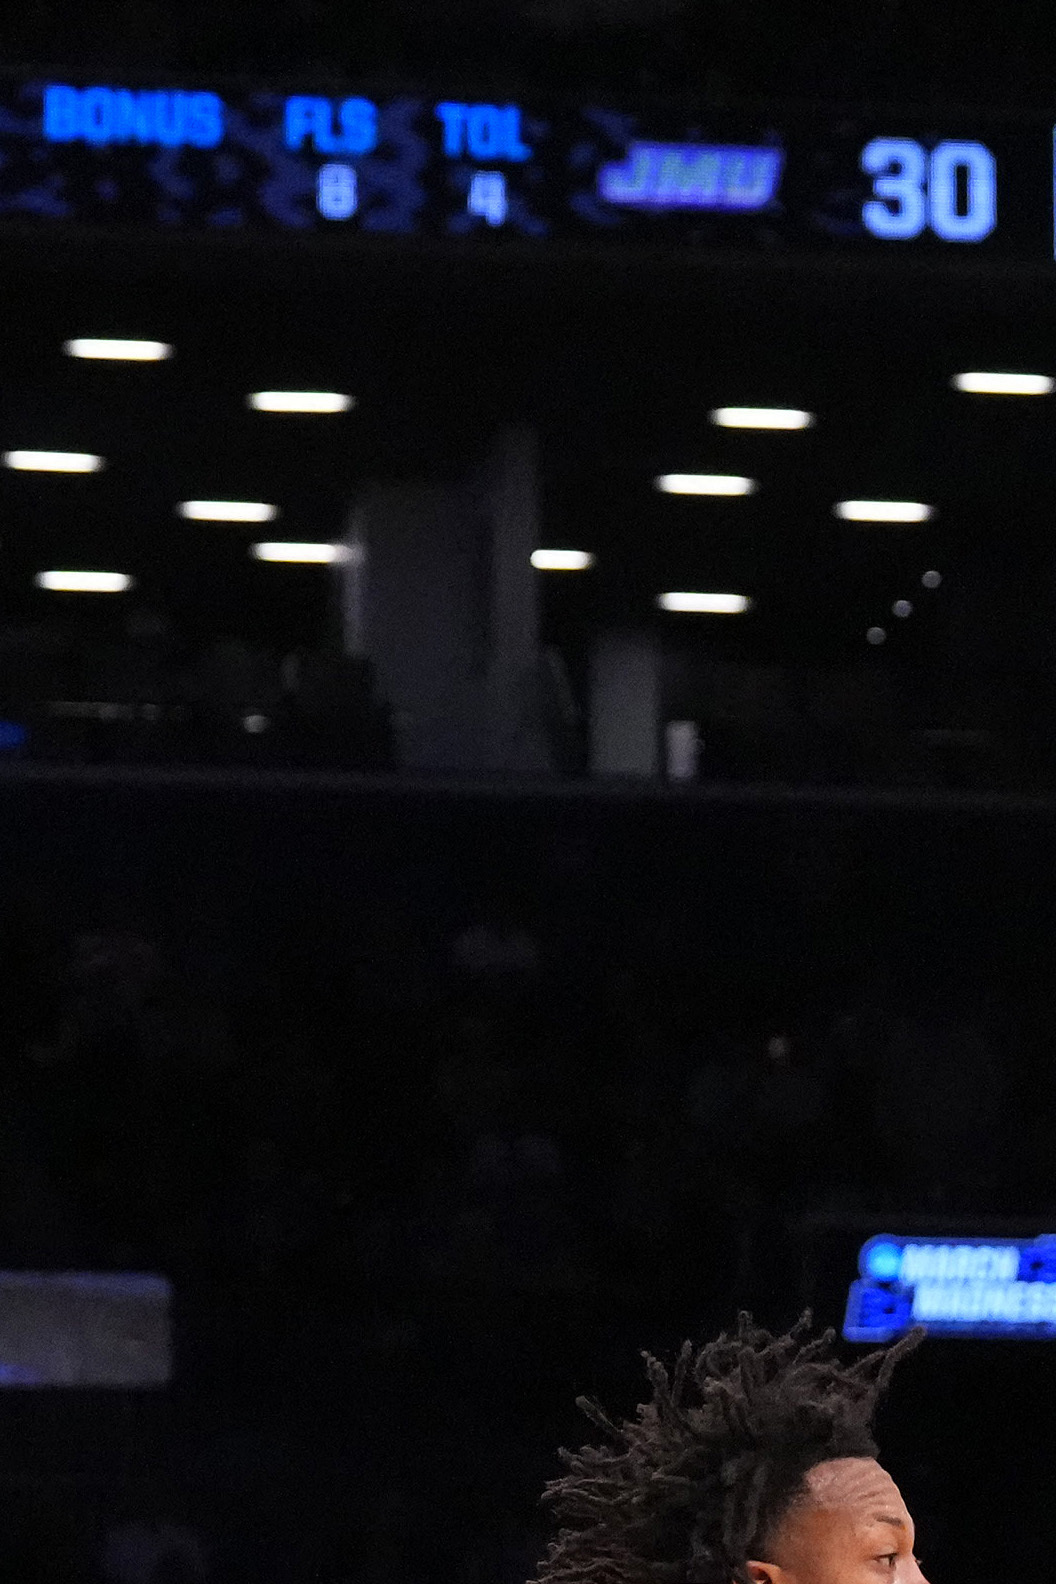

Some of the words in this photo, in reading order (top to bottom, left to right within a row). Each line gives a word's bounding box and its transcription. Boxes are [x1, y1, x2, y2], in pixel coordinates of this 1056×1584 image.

[42, 84, 224, 149] BONUS
[283, 94, 379, 156] FLS
[434, 101, 533, 163] TOL
[861, 136, 998, 243] 30
